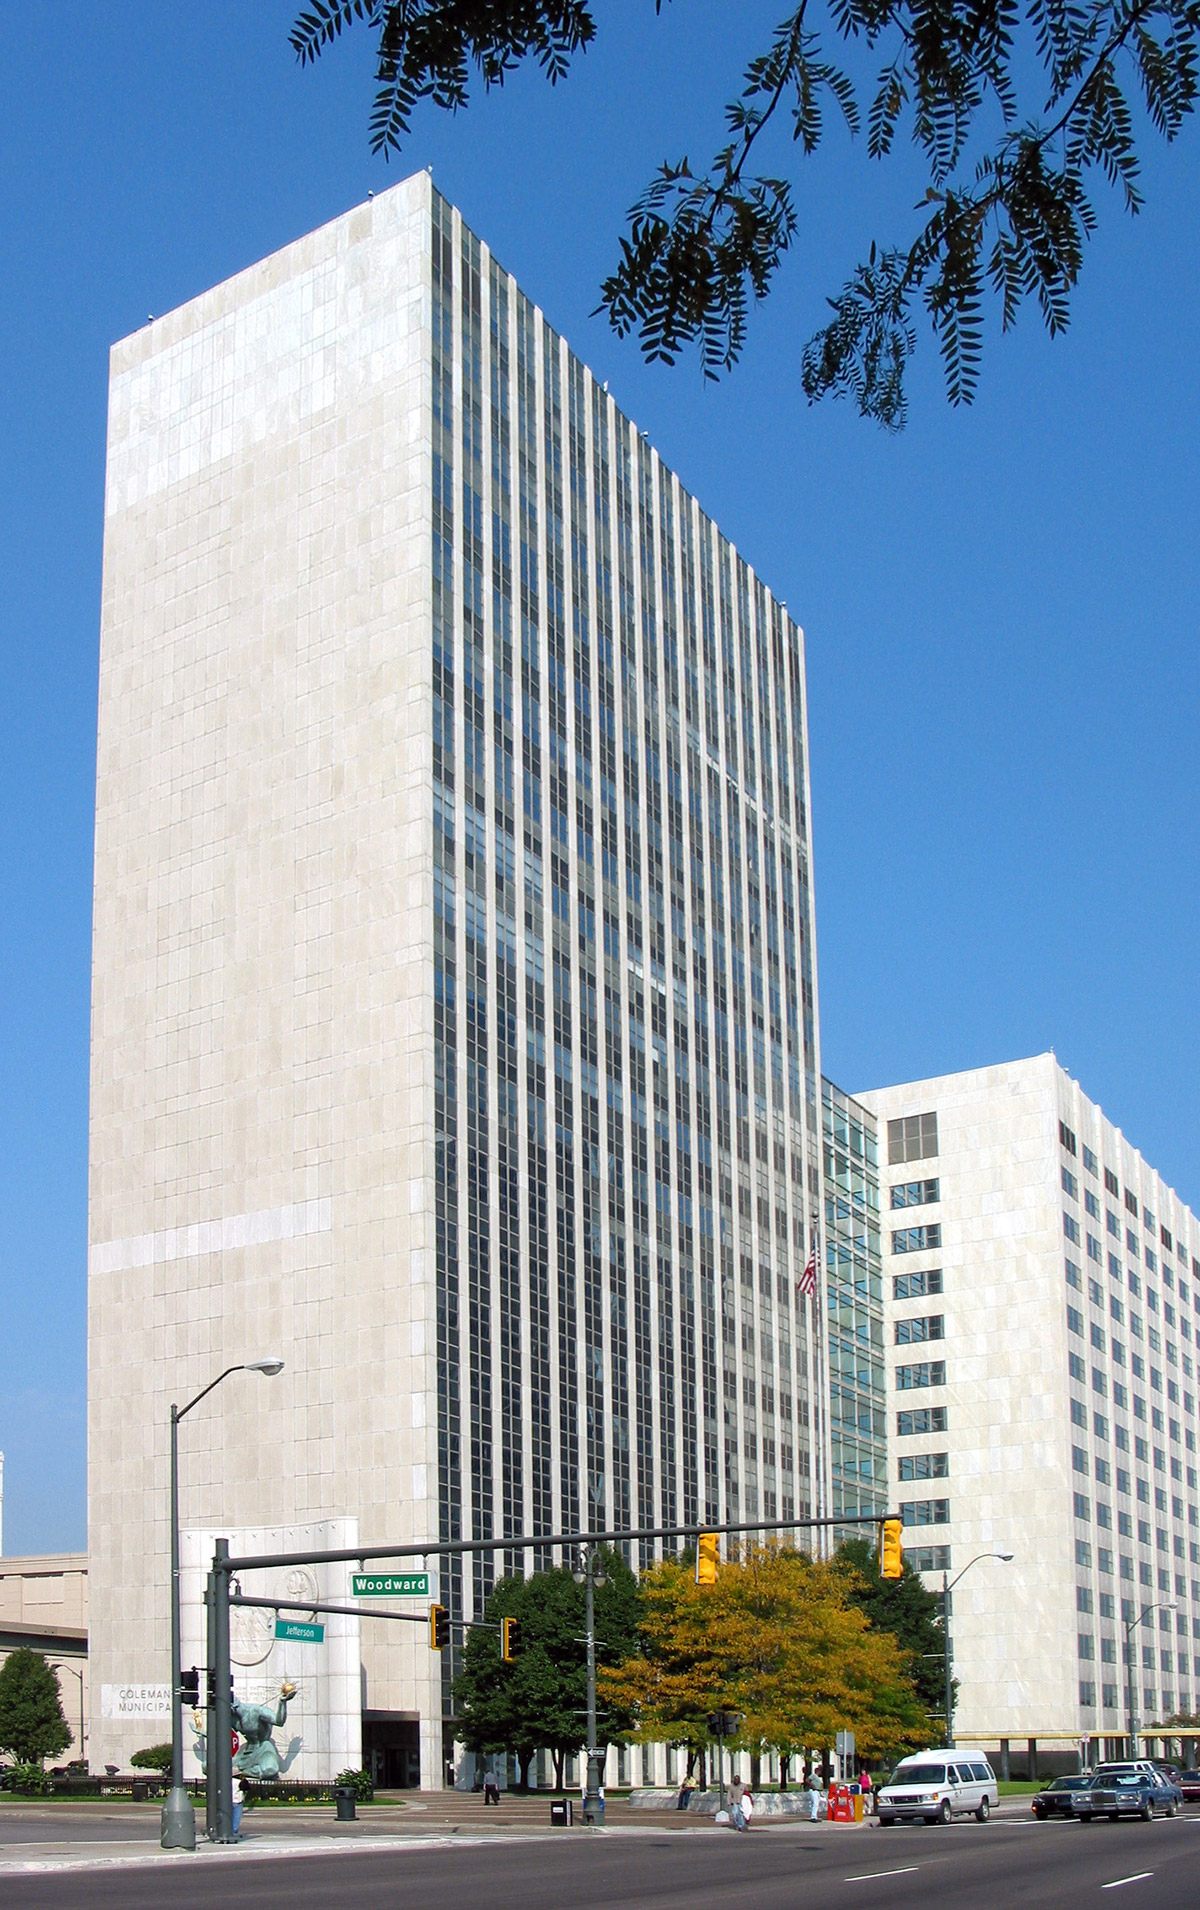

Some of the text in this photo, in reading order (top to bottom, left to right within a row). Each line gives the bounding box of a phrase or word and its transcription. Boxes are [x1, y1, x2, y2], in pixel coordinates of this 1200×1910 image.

[355, 1578, 425, 1591] Woodward
[286, 1625, 315, 1638] Jefferson
[119, 1689, 171, 1699] COLEMAN
[119, 1702, 172, 1712] MUNICIPA
